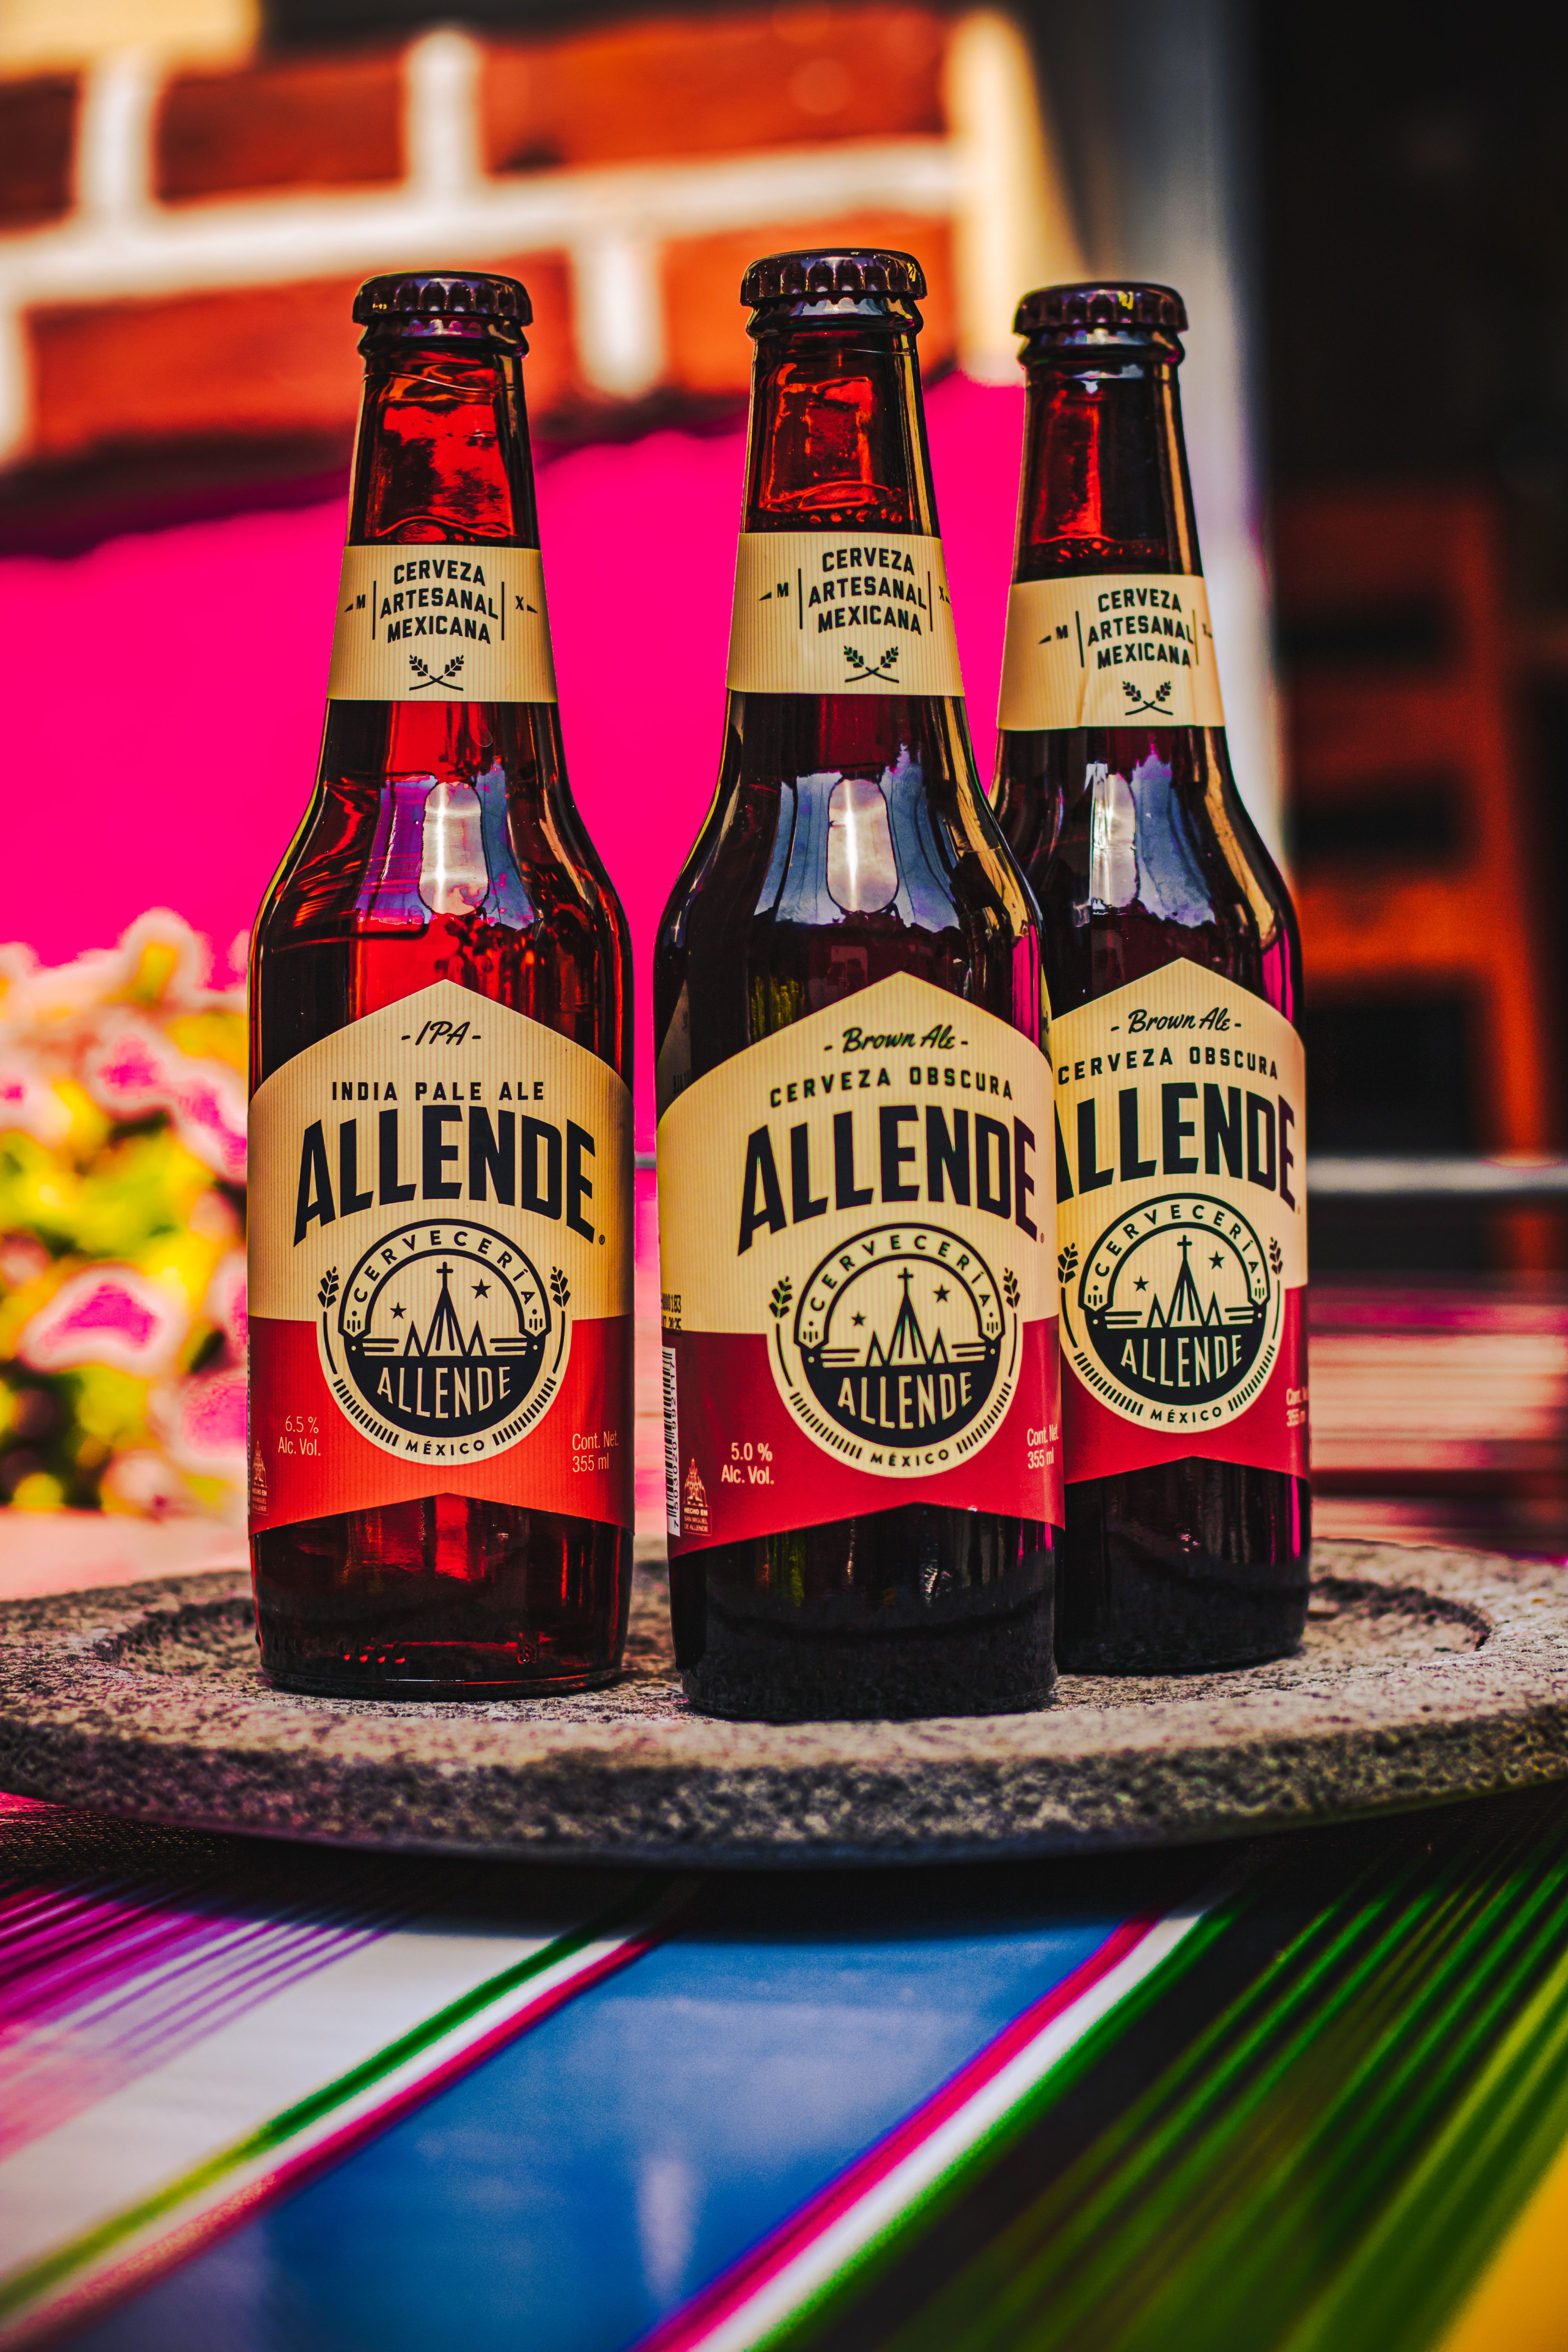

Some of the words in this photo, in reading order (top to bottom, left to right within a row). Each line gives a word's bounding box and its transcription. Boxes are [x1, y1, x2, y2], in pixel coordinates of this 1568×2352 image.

[394, 560, 485, 586] CERVEZA
[822, 548, 915, 575] CERVEZA
[356, 595, 365, 609] M
[380, 588, 498, 619] ARTESANAL
[515, 595, 524, 611] X
[777, 583, 788, 598] M
[808, 576, 926, 610] ARTESANAL
[1098, 588, 1181, 613] CERVEZA
[387, 615, 490, 644] MEXICANA
[818, 605, 922, 636] MEXICANA
[1056, 625, 1069, 640] M
[1088, 615, 1194, 646] ARTESANAL
[1098, 642, 1191, 669] MEXICANA
[1128, 1009, 1196, 1034] Brown
[1200, 1007, 1230, 1031] Ale
[842, 1027, 916, 1053] Brown
[920, 1024, 955, 1049] Ale
[1058, 1047, 1173, 1085] CERVEZA
[1190, 1047, 1277, 1080] OBSCURA
[332, 1082, 397, 1101] INDIA
[416, 1082, 481, 1100] PALE
[499, 1082, 544, 1100] ALE
[770, 1068, 890, 1108] CERVEZA
[909, 1067, 1013, 1100] OBSCURA
[294, 1105, 595, 1247] ALLENDE
[738, 1105, 1037, 1256] ALLENDE
[1096, 1204, 1259, 1277] CERVECERÍA
[354, 1230, 535, 1305] CERVECERÍA
[810, 1235, 990, 1311] CERVECERÍA
[1121, 1334, 1242, 1387] ALLENDE
[377, 1367, 510, 1418] ALLENDE
[838, 1372, 972, 1429] ALLENDE
[285, 1415, 303, 1432] 6.5
[308, 1416, 319, 1434] %
[1150, 1406, 1221, 1423] MÉXICO
[278, 1437, 296, 1454] Alc.
[299, 1438, 321, 1456] Vol.
[405, 1440, 484, 1456] MÉXICO
[572, 1433, 600, 1450] Cont.
[604, 1430, 619, 1447] Net.
[1027, 1427, 1048, 1446] Cont.
[573, 1455, 594, 1472] 355
[598, 1453, 608, 1470] ml
[731, 1443, 753, 1461] 5.0
[758, 1443, 773, 1461] %
[870, 1450, 949, 1466] MÉXICO
[1028, 1449, 1044, 1469] 355
[1046, 1446, 1054, 1465] ml
[721, 1465, 745, 1484] Alc.
[748, 1465, 774, 1485] Vol.
[692, 1517, 708, 1525] MIGUEL
